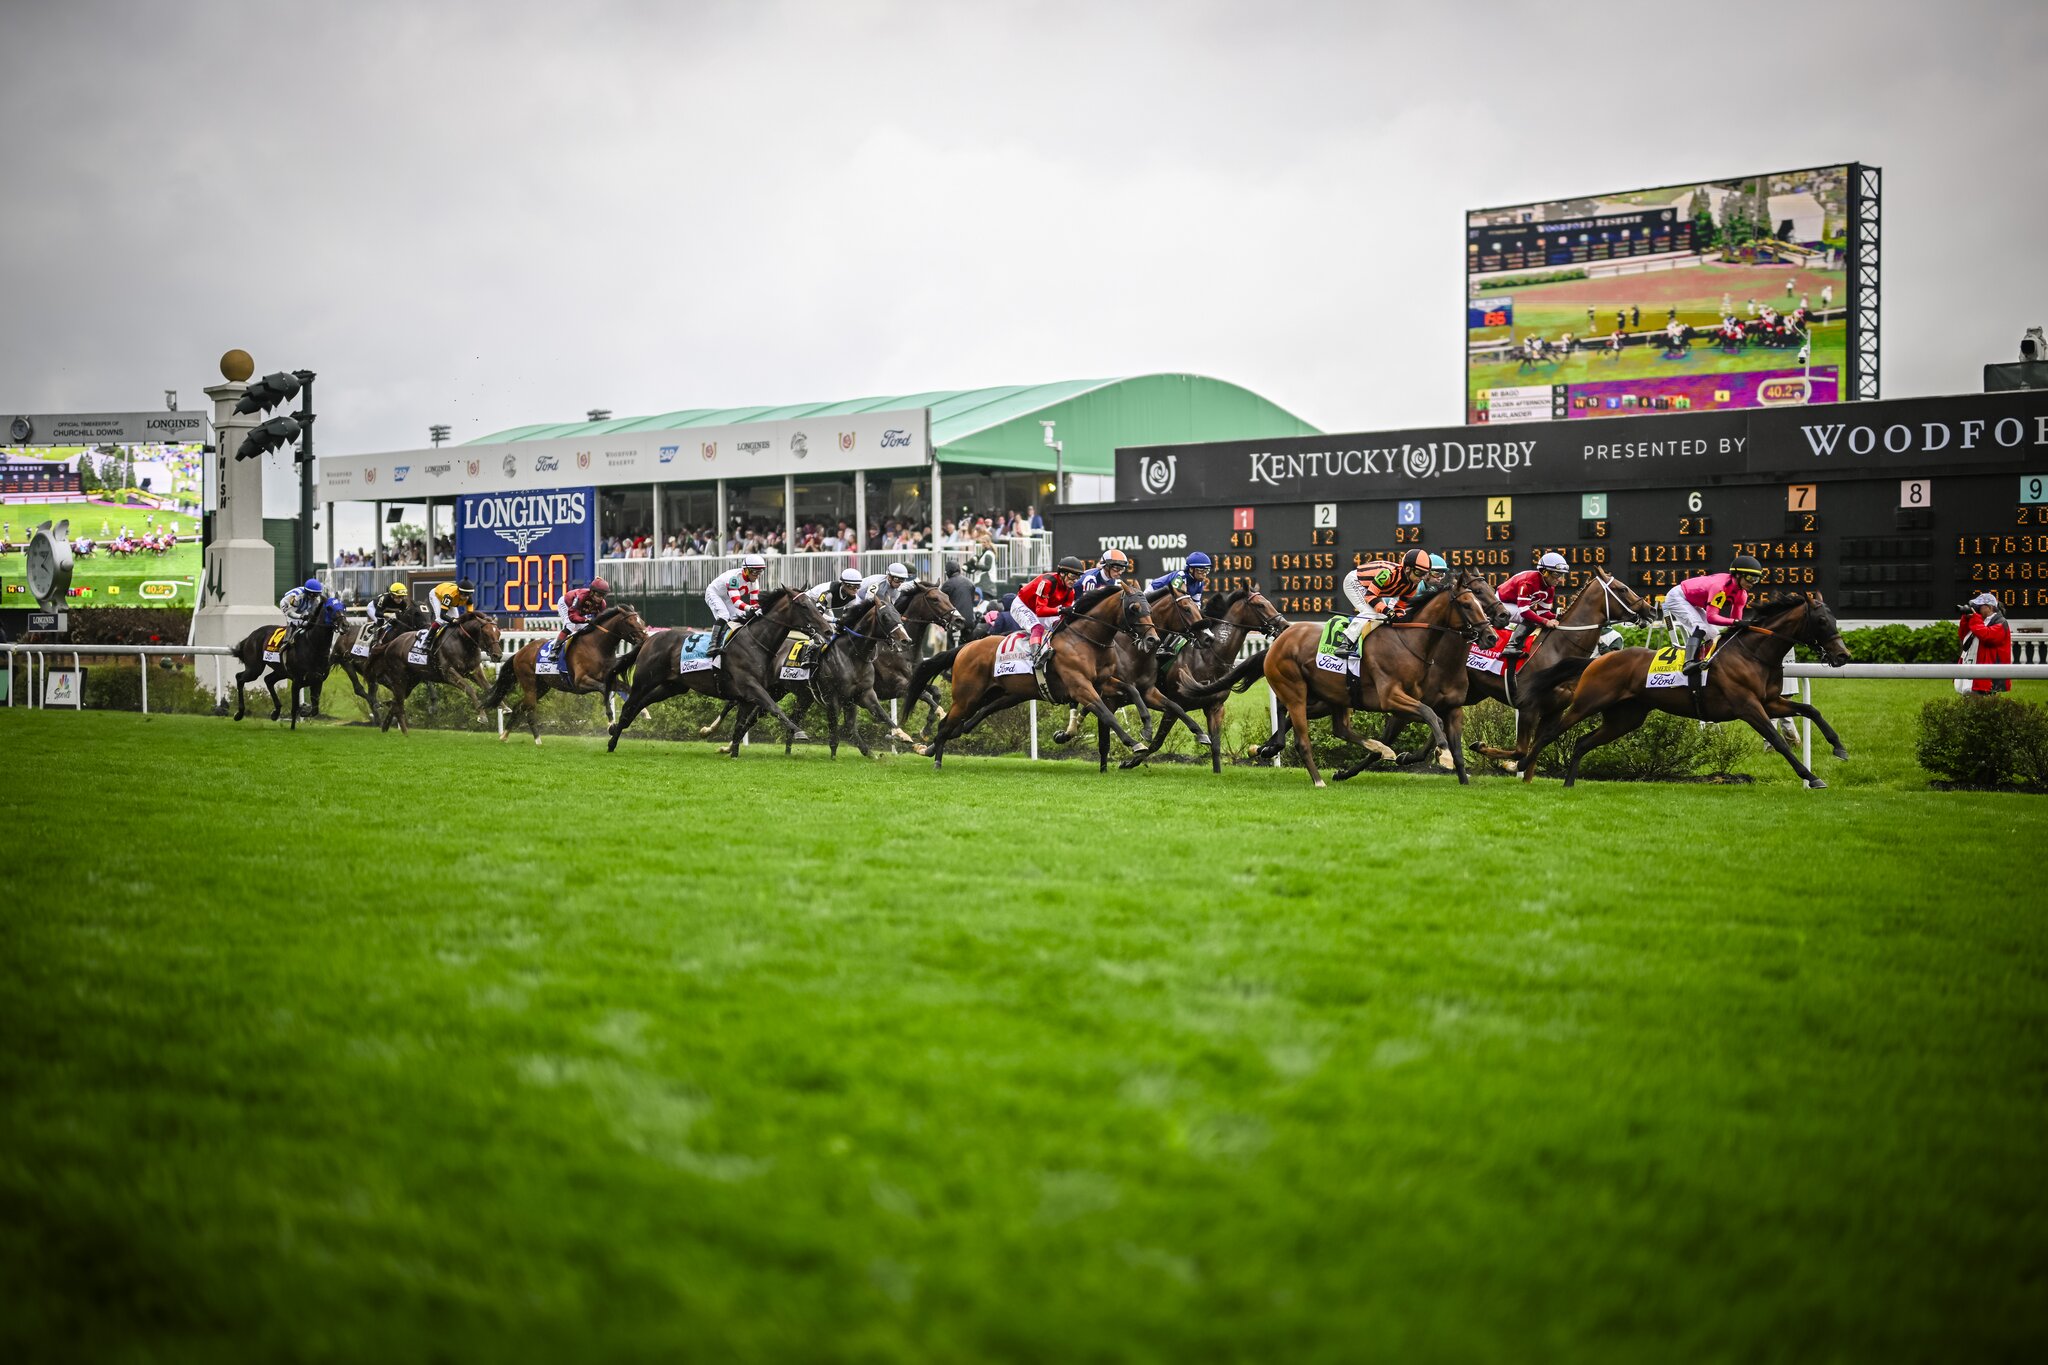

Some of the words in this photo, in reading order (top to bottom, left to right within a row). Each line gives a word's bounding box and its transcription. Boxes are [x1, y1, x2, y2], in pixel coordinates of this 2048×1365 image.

[1767, 385, 1793, 398] 40.2
[147, 418, 201, 429] LONGINES
[53, 429, 94, 438] CHURCHILL
[96, 428, 124, 437] DOWNS
[880, 429, 911, 448] Ford
[736, 440, 771, 451] LONGINES
[218, 431, 226, 510] FINISH
[535, 455, 559, 472] Ford
[1249, 447, 1399, 486] KENTUCKY
[1442, 440, 1537, 473] DERBY
[1584, 439, 1708, 461] PRESENTED
[1719, 437, 1747, 454] BY
[1796, 487, 1810, 509] 7
[1909, 482, 1923, 504] 8
[2028, 478, 2043, 500] 9
[1493, 499, 1506, 519] 4
[1588, 496, 1601, 516] 5
[1688, 491, 1703, 512] 6
[464, 493, 586, 529] LONGINES
[1239, 510, 1248, 528] 1
[1321, 506, 1331, 525] 2
[1403, 502, 1415, 523] 3
[1485, 524, 1511, 540] 15
[1596, 520, 1607, 536] 5
[1679, 517, 1706, 535] 21
[1803, 514, 1815, 532] 2
[1098, 536, 1144, 552] TOTAL
[1147, 533, 1188, 550] ODDS
[1230, 531, 1254, 547] 40
[1311, 530, 1335, 545] 12
[1271, 552, 1335, 570] 194155
[1630, 543, 1707, 564] 112114
[505, 554, 568, 612] 20.0
[1281, 574, 1335, 591] 76703
[1281, 595, 1334, 613] 74684
[1318, 655, 1344, 672] Ford
[1658, 647, 1678, 665] 4
[996, 661, 1016, 674] Ford
[1650, 673, 1676, 686] Ford
